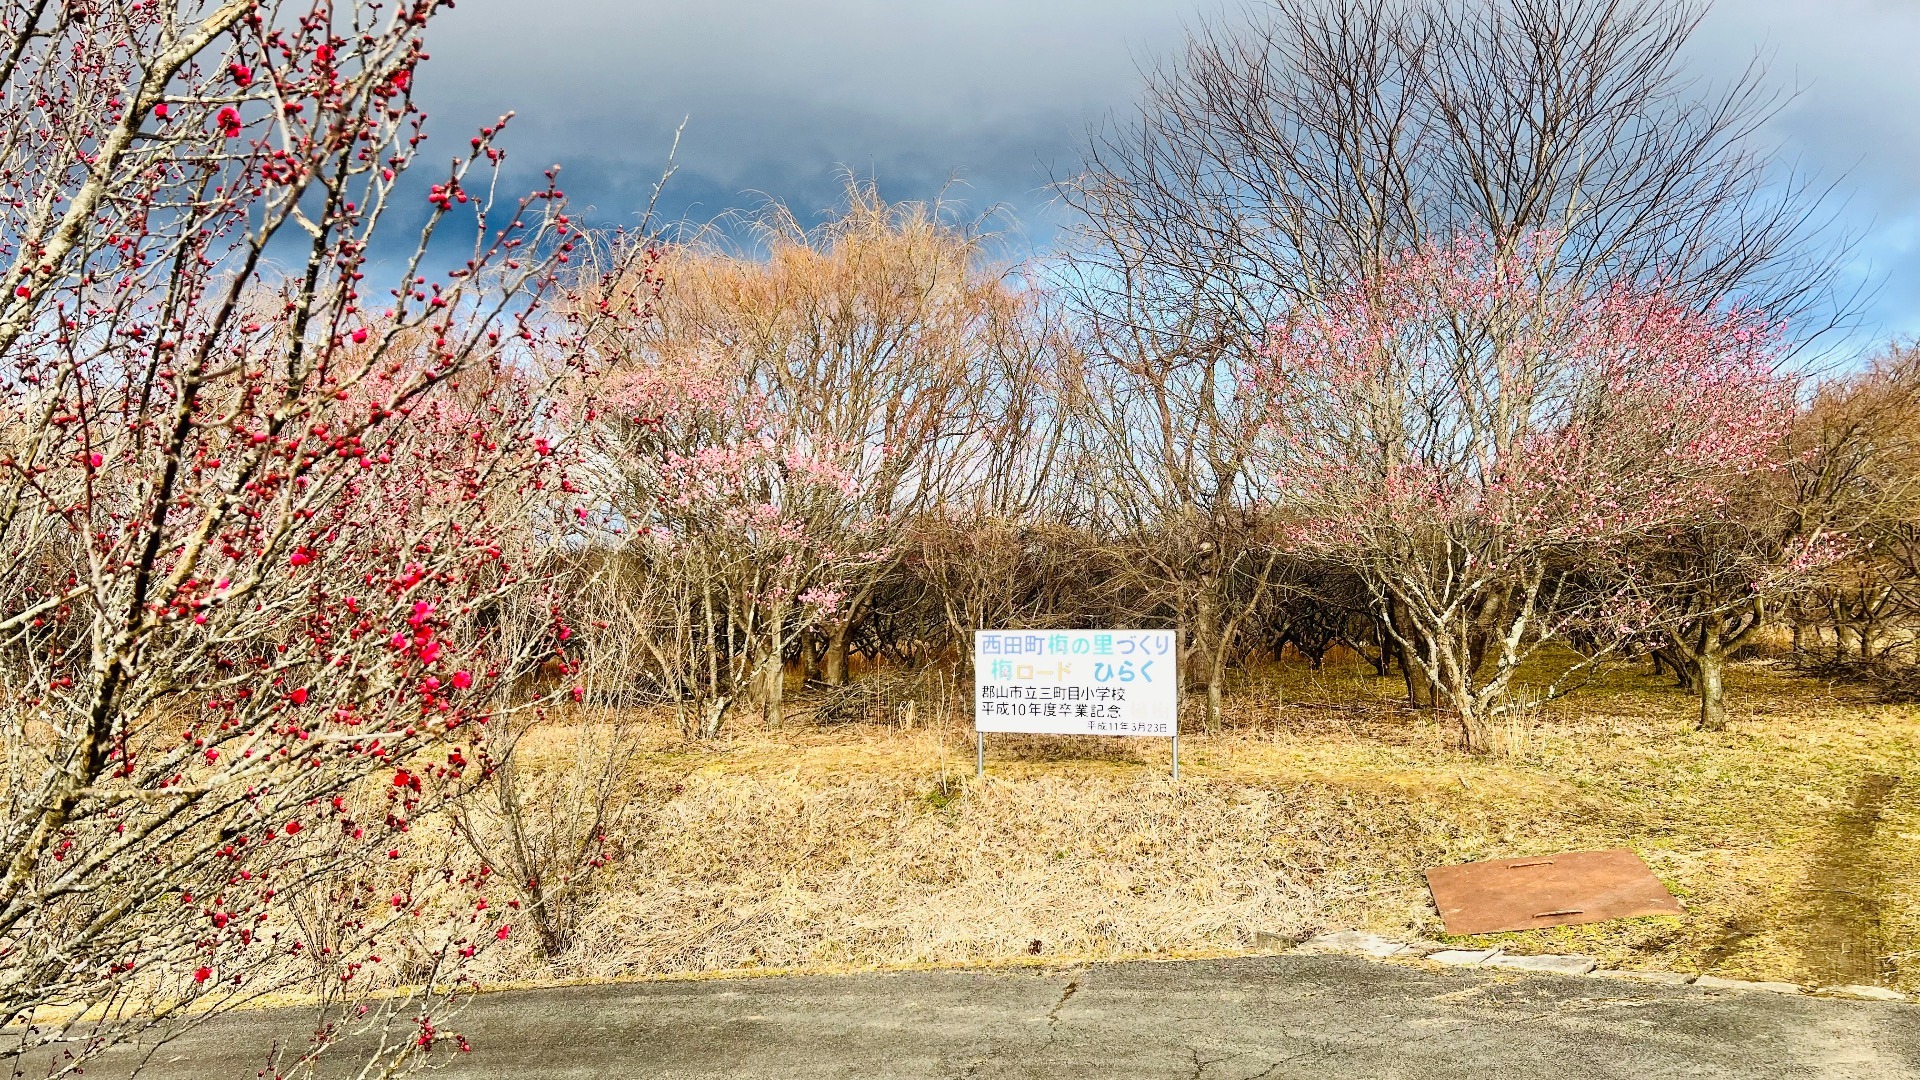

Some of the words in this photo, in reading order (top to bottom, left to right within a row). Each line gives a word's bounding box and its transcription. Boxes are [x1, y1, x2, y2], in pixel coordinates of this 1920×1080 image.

[982, 634, 1169, 655] 西田町梅の里づくり
[992, 659, 1072, 681] 梅ロード
[1094, 660, 1154, 683] ひらく
[981, 685, 1126, 701] 郡山市立三町目小学校
[981, 702, 1121, 718] 平成10年度卒業記念
[1087, 720, 1167, 733] 平成11年3月23日
